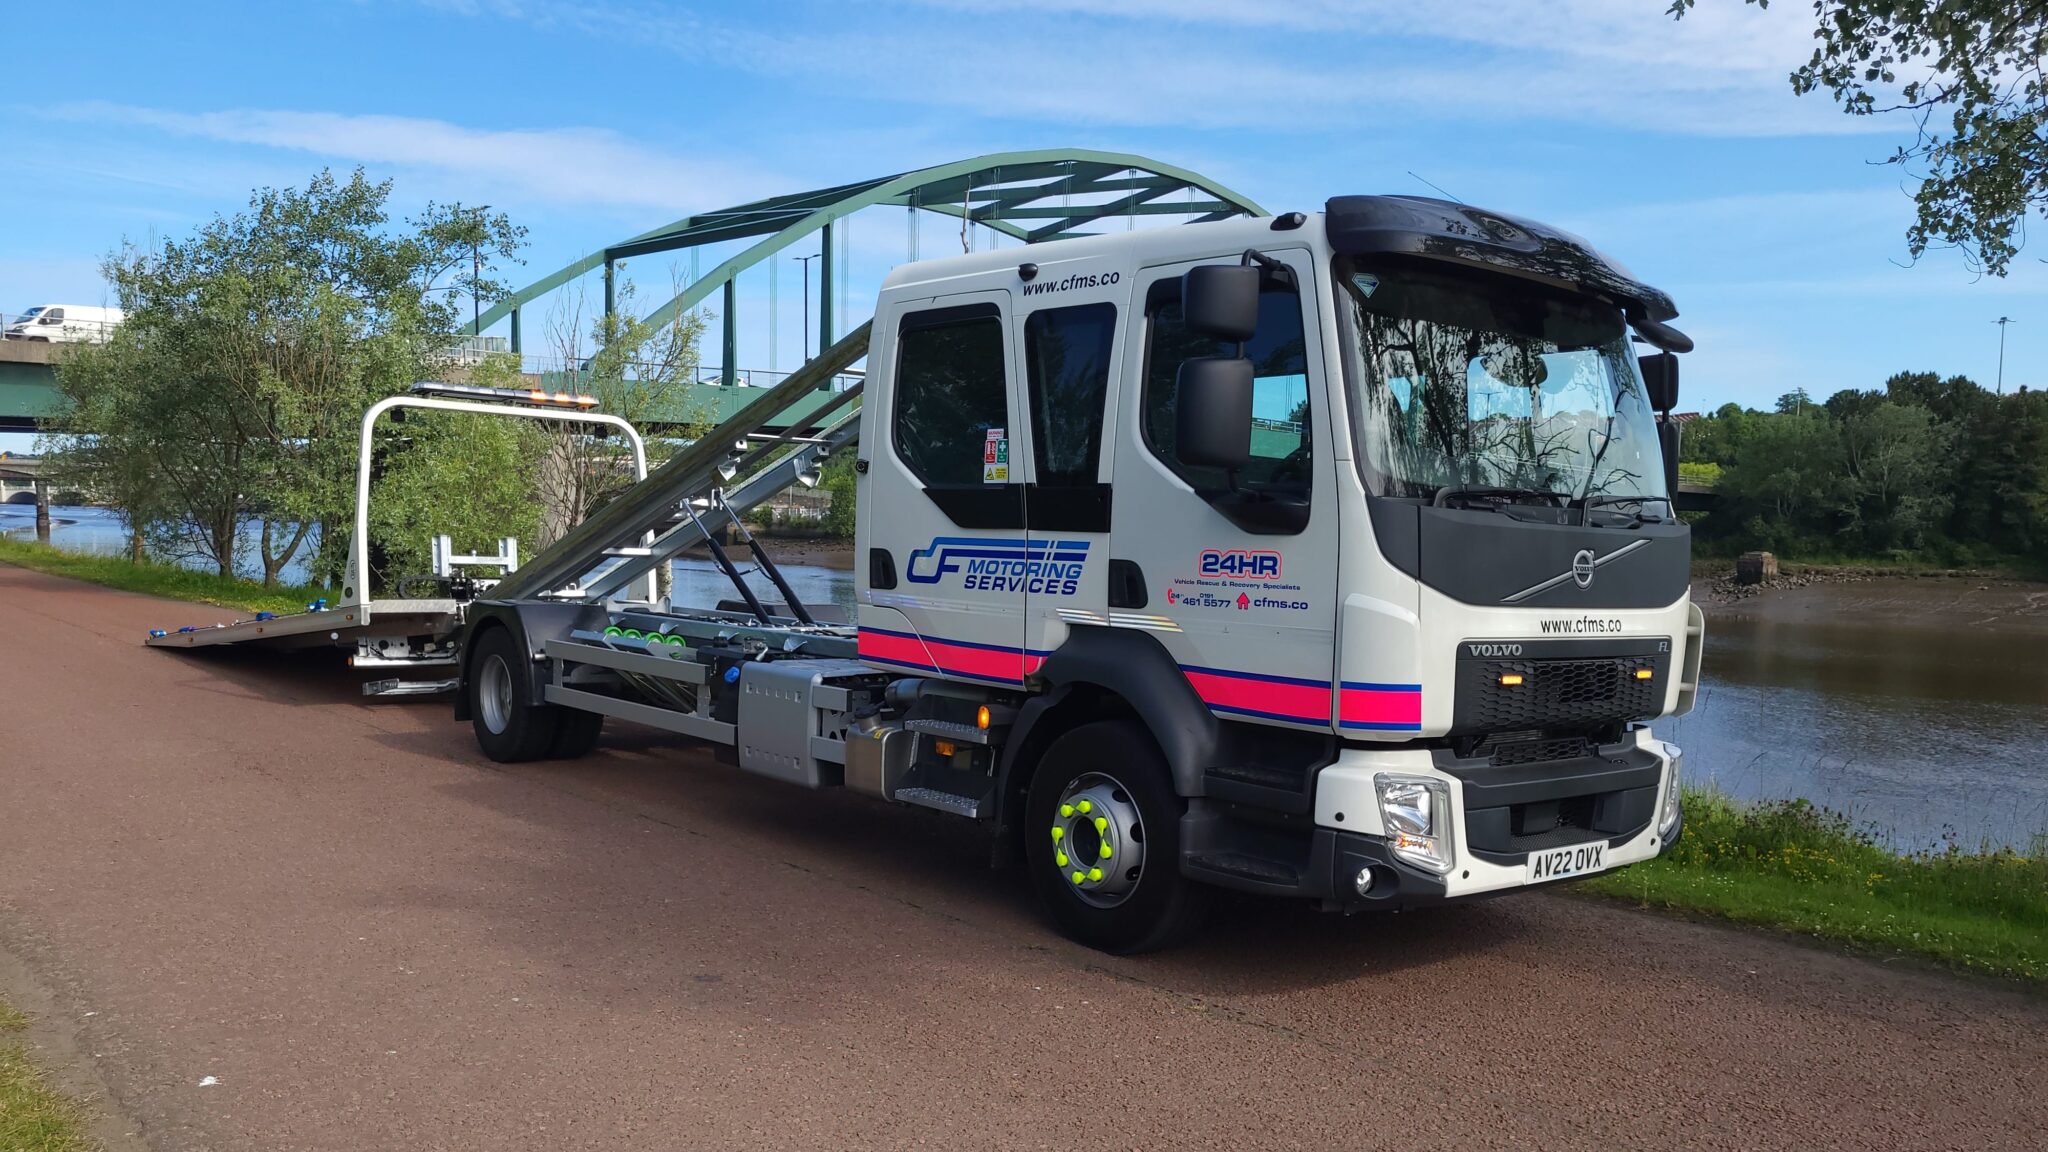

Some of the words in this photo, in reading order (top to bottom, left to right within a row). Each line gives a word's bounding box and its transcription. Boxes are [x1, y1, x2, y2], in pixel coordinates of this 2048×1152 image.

[1023, 272, 1120, 296] www.cfms.co
[967, 559, 1083, 579] MOTORING
[1202, 553, 1278, 575] 24HR
[964, 575, 1078, 595] SERVICES
[1182, 597, 1201, 606] 461
[1203, 598, 1231, 608] 5577
[1253, 597, 1309, 610] cfms.co
[1540, 615, 1622, 633] www.cfms.co
[1468, 644, 1523, 657] VOLVO
[1533, 850, 1573, 879] AV22
[1575, 845, 1603, 871] OVX
